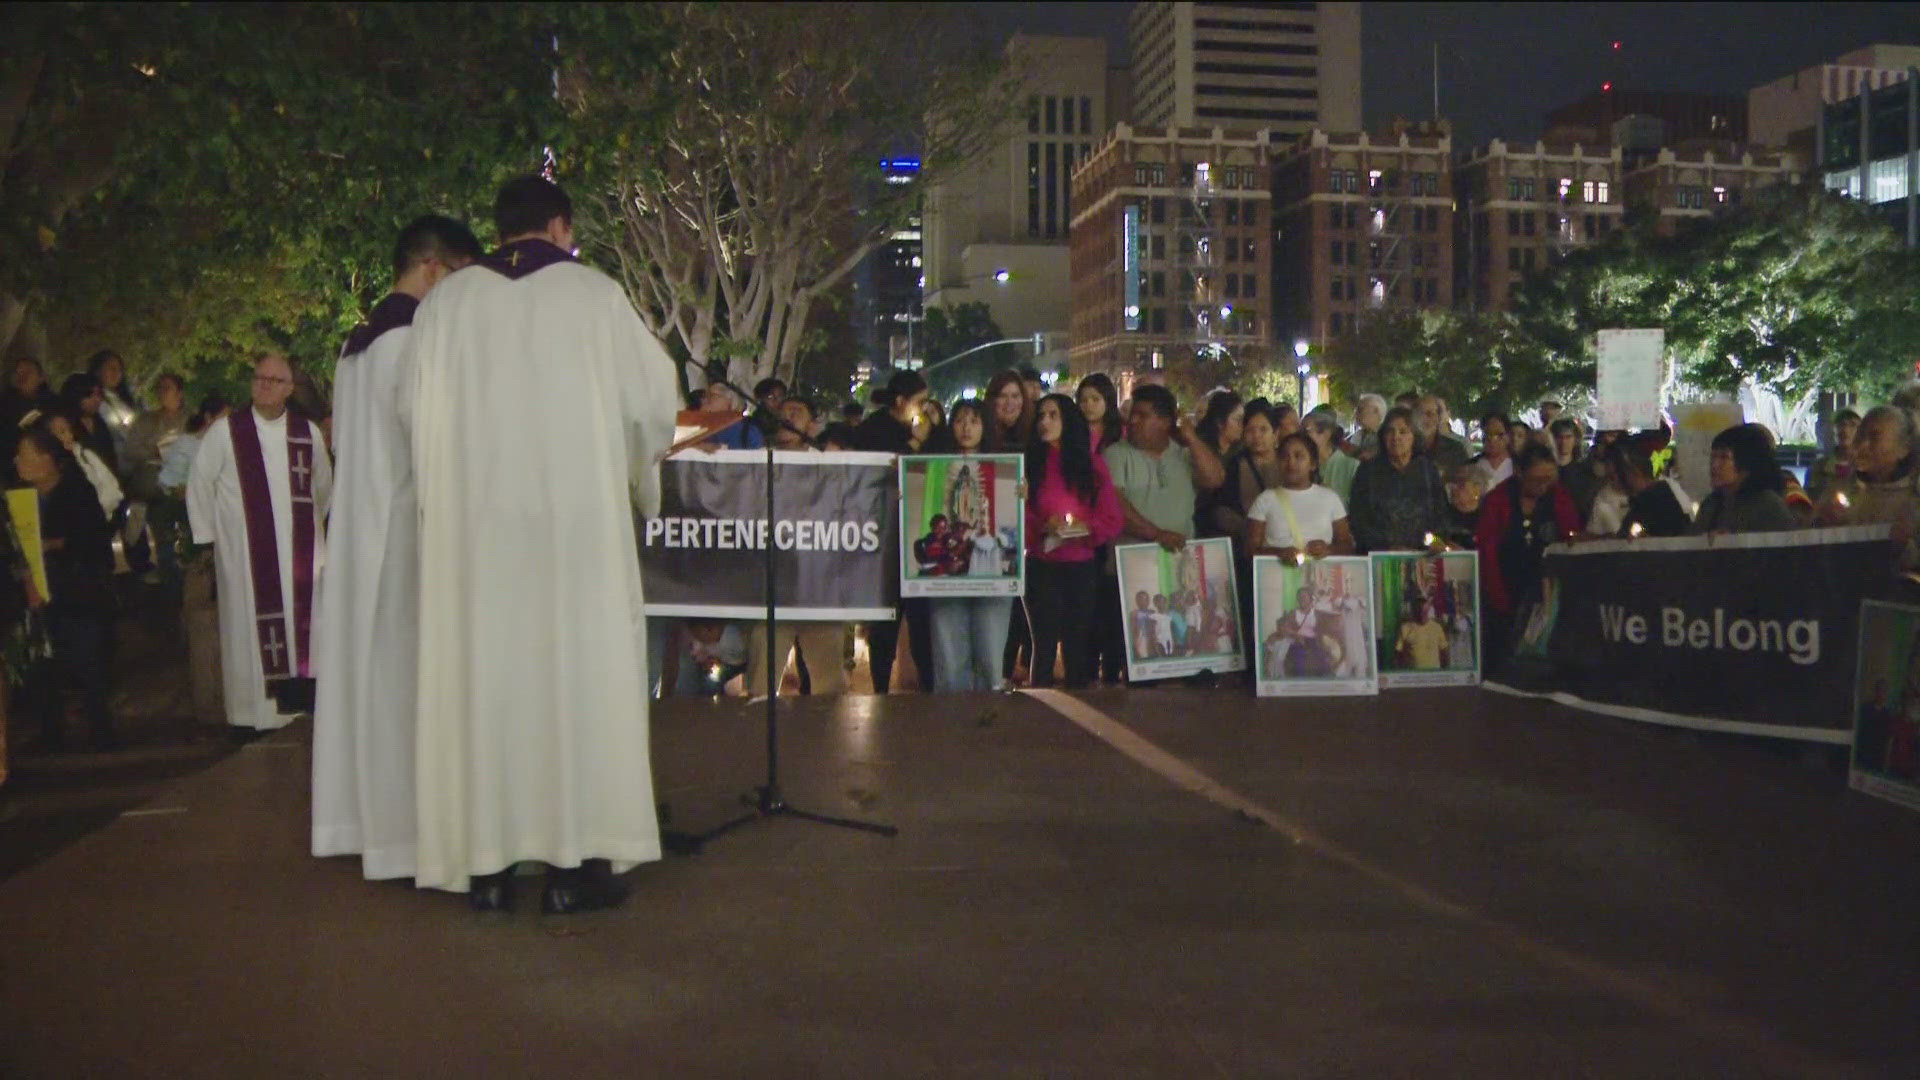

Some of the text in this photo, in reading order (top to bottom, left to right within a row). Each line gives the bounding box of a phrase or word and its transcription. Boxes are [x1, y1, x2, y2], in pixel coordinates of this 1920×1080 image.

[645, 517, 880, 552] PERTENECEMOS
[1600, 603, 1820, 665] We Belong
